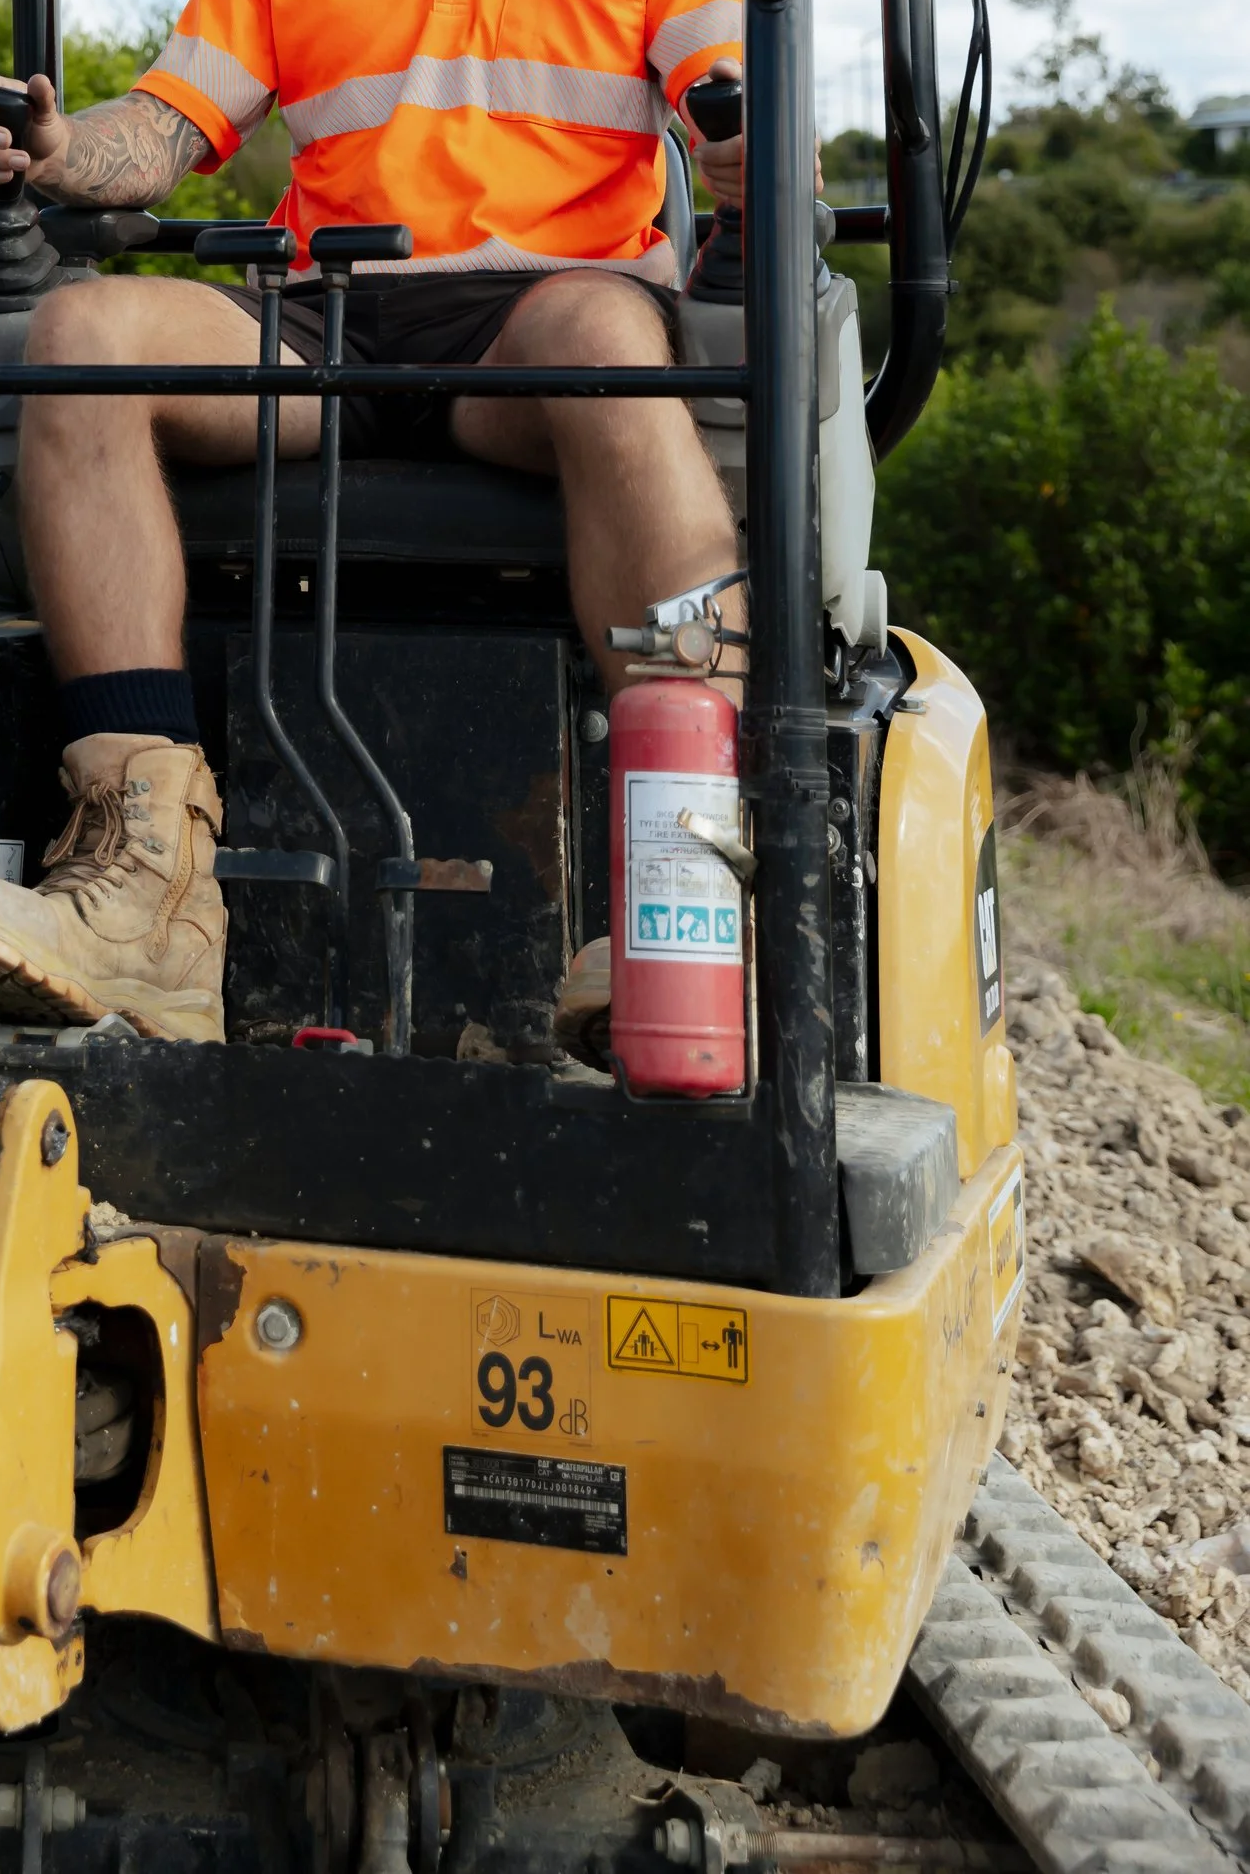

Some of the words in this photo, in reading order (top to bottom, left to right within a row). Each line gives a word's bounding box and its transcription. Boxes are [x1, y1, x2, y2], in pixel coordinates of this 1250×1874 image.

[659, 846, 719, 856] INSTRUCTION
[978, 887, 998, 980] CAT
[477, 1350, 555, 1432] 93
[558, 1398, 589, 1436] dB
